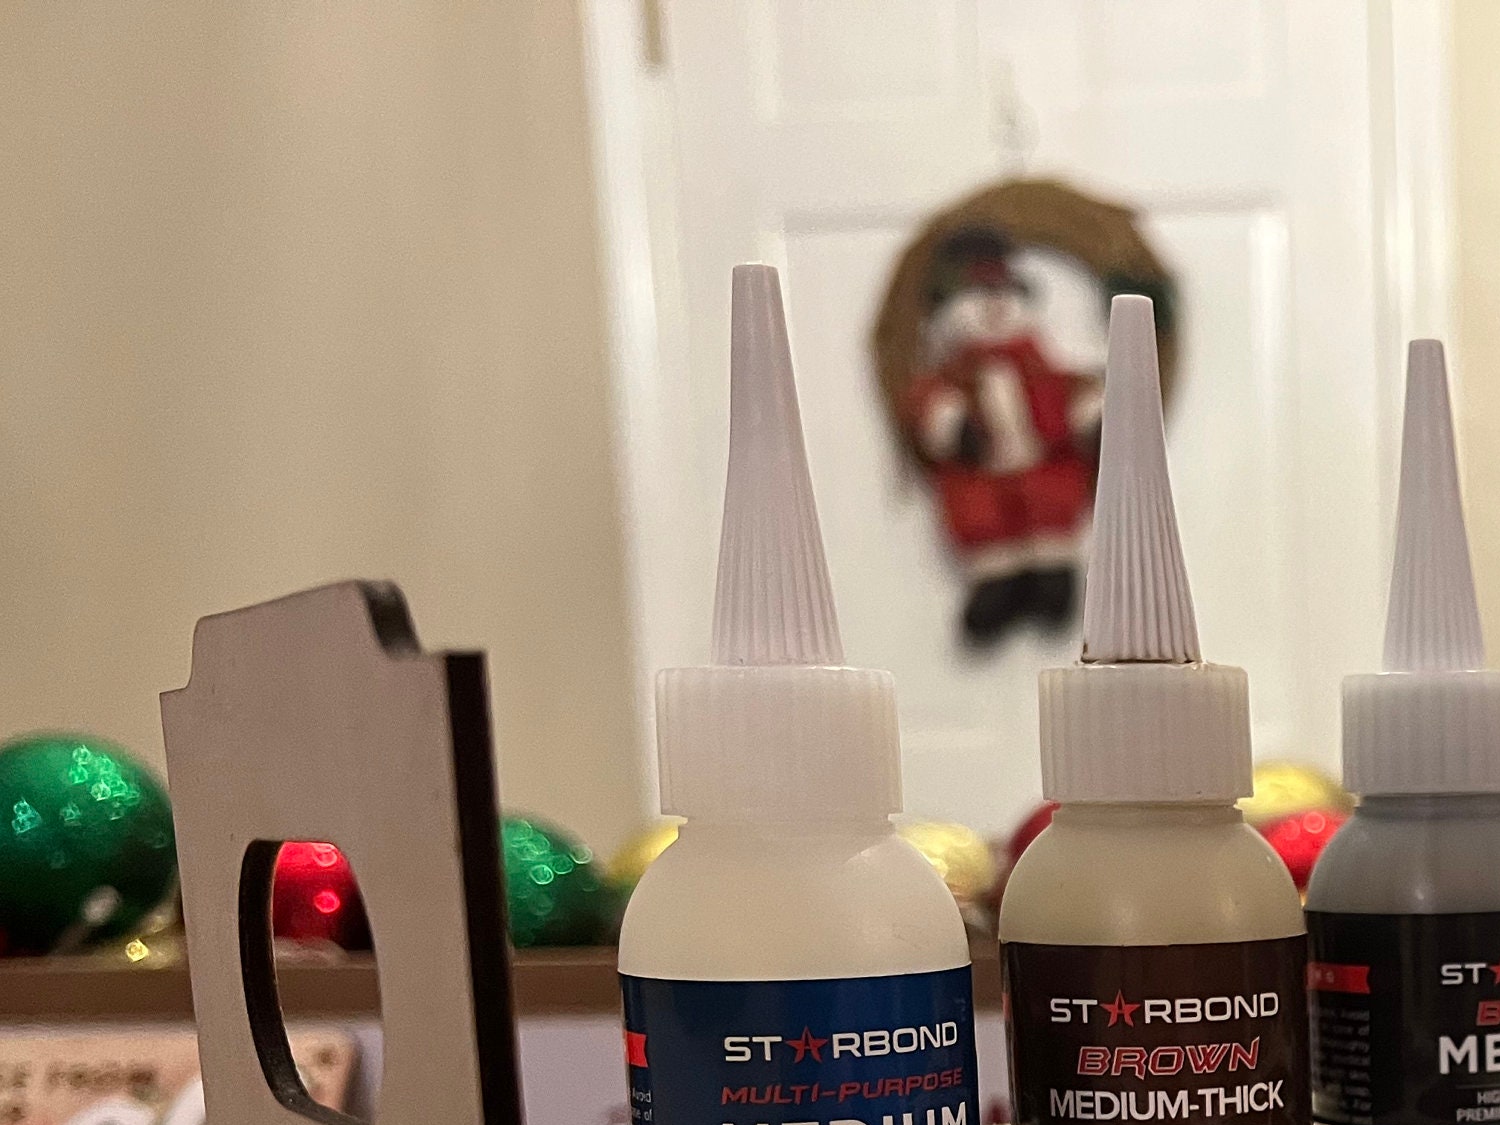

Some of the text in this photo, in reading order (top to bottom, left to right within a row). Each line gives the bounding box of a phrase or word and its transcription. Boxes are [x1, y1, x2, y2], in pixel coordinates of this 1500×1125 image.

[1050, 988, 1279, 1028] STARBOND
[724, 1021, 958, 1064] STARBOND
[1077, 1036, 1261, 1081] BROWN
[721, 1067, 963, 1105] MULTI-PURPOSE
[1050, 1080, 1285, 1121] MEDIUM-THICK
